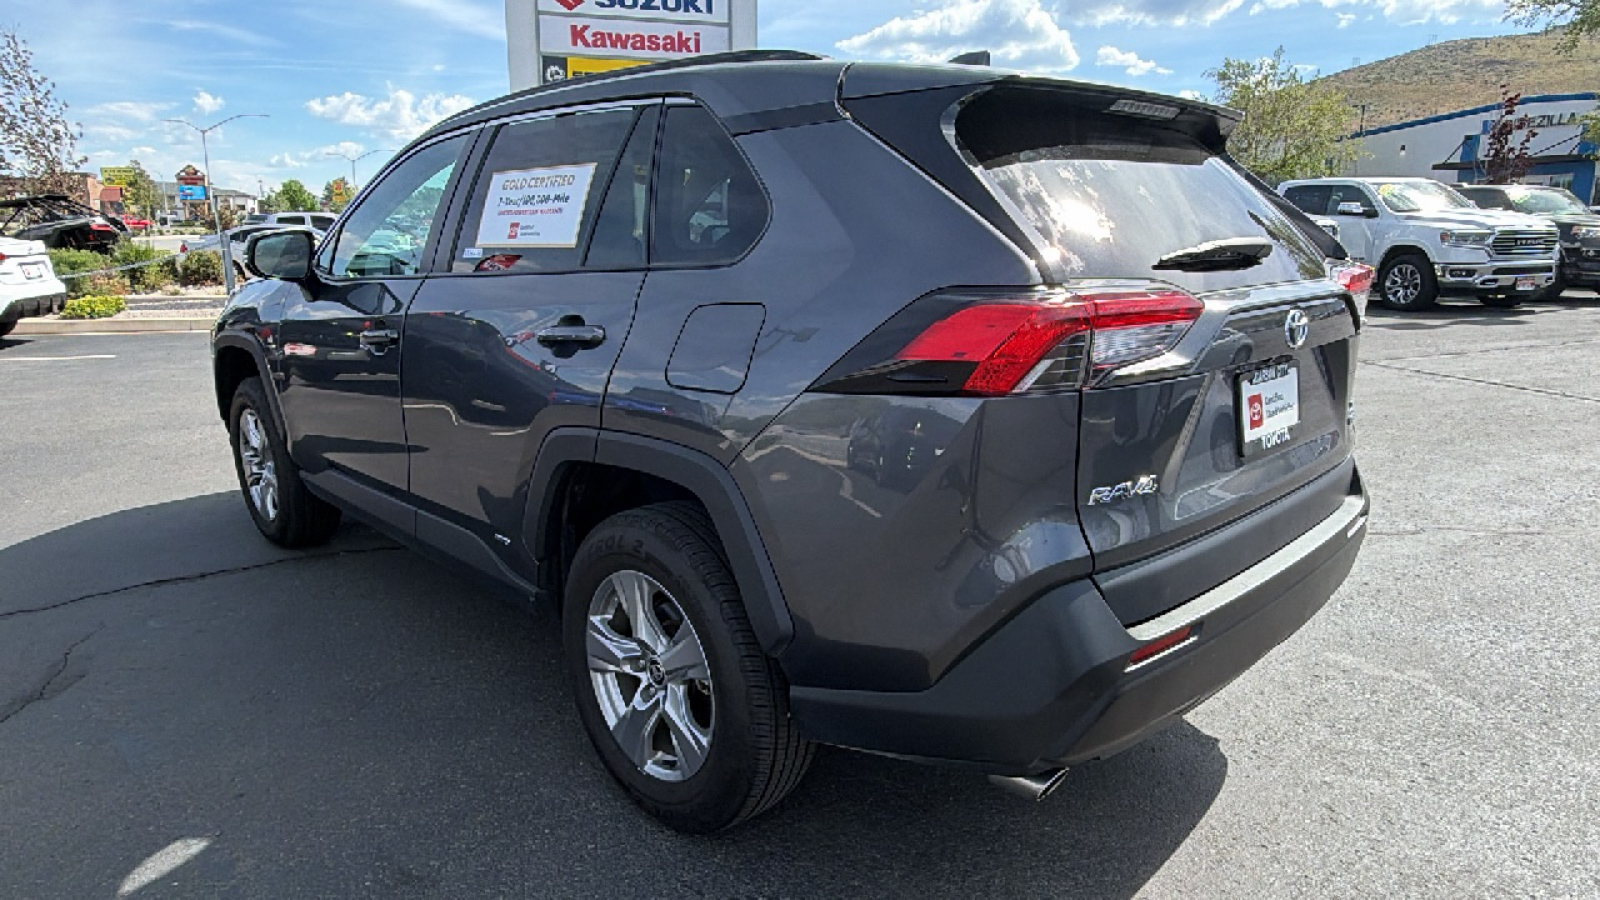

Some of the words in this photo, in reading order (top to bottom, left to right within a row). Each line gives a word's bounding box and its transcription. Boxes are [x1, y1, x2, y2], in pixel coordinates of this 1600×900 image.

[570, 24, 701, 53] Kawasaki
[502, 178, 527, 191] GOLD
[528, 174, 576, 189] CERTIFIED
[1260, 426, 1291, 450] TOYOTA
[1087, 474, 1158, 506] RAV4
